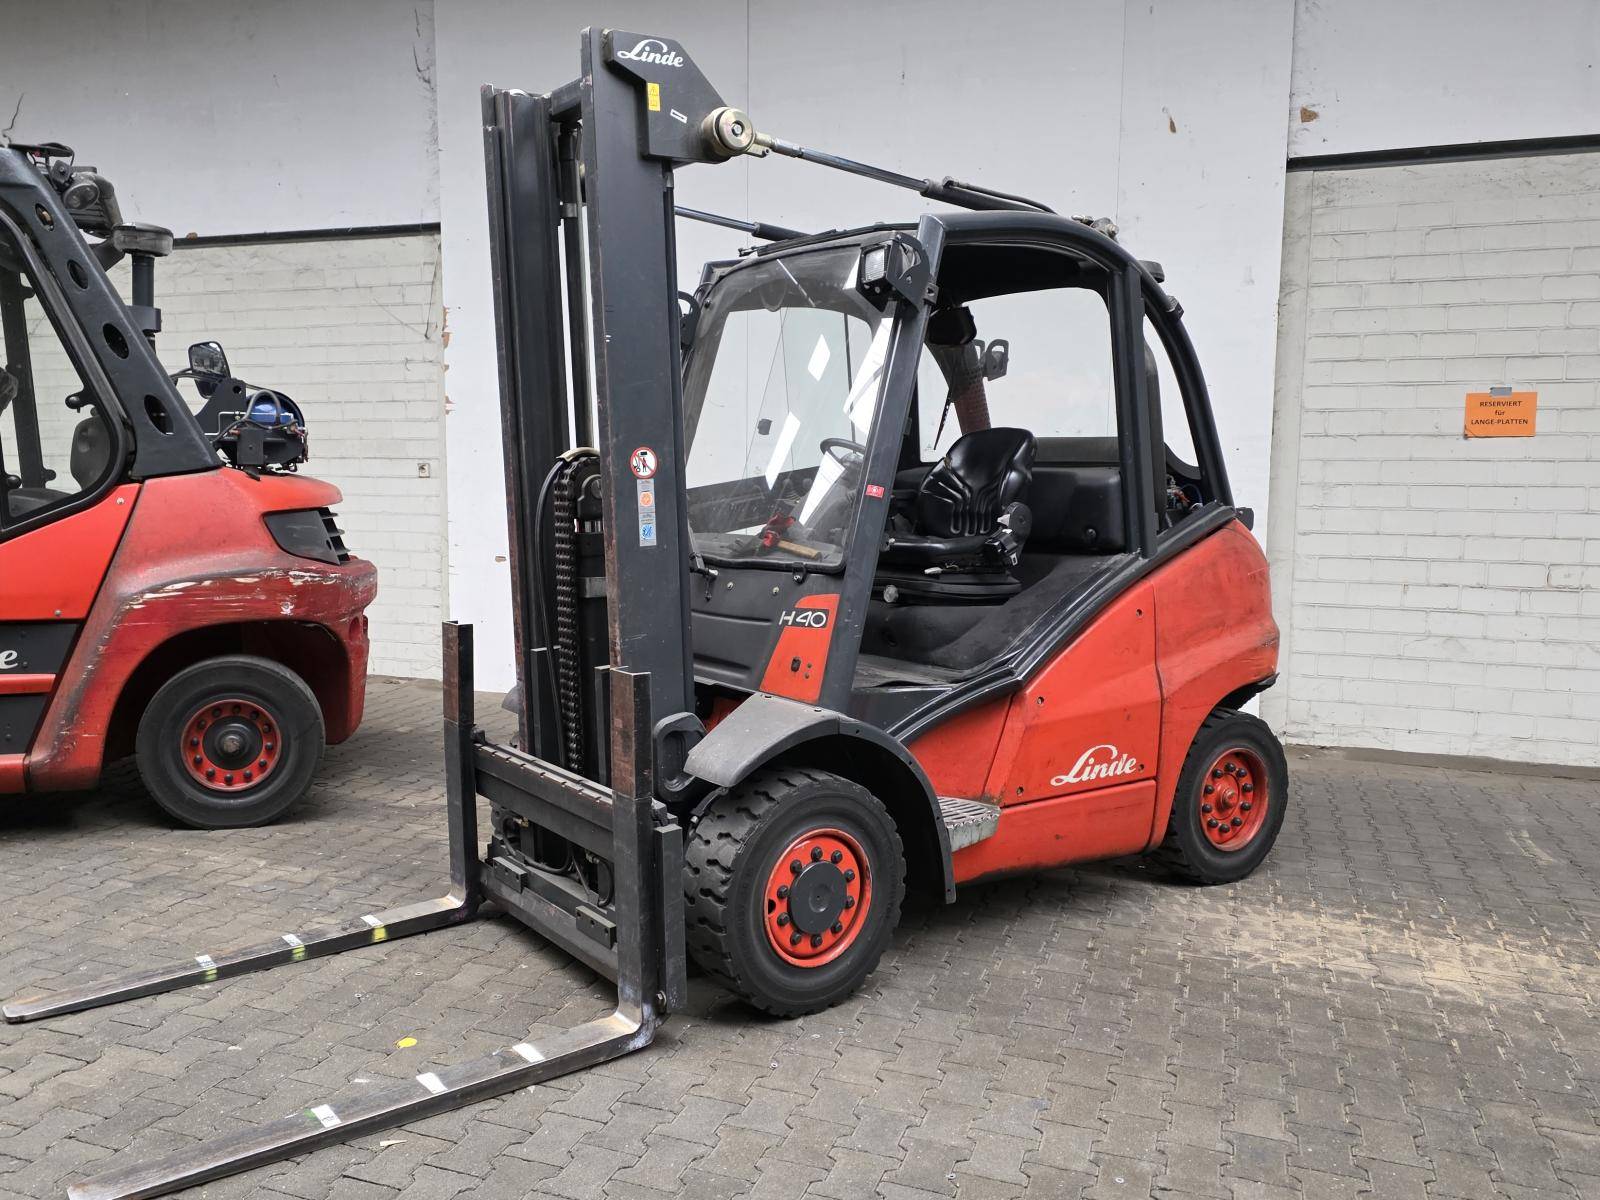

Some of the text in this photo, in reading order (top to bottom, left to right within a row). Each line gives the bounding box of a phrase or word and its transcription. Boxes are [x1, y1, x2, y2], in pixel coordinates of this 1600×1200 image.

[617, 39, 684, 68] Linde
[778, 610, 827, 627] H40
[1050, 744, 1137, 787] Linde
